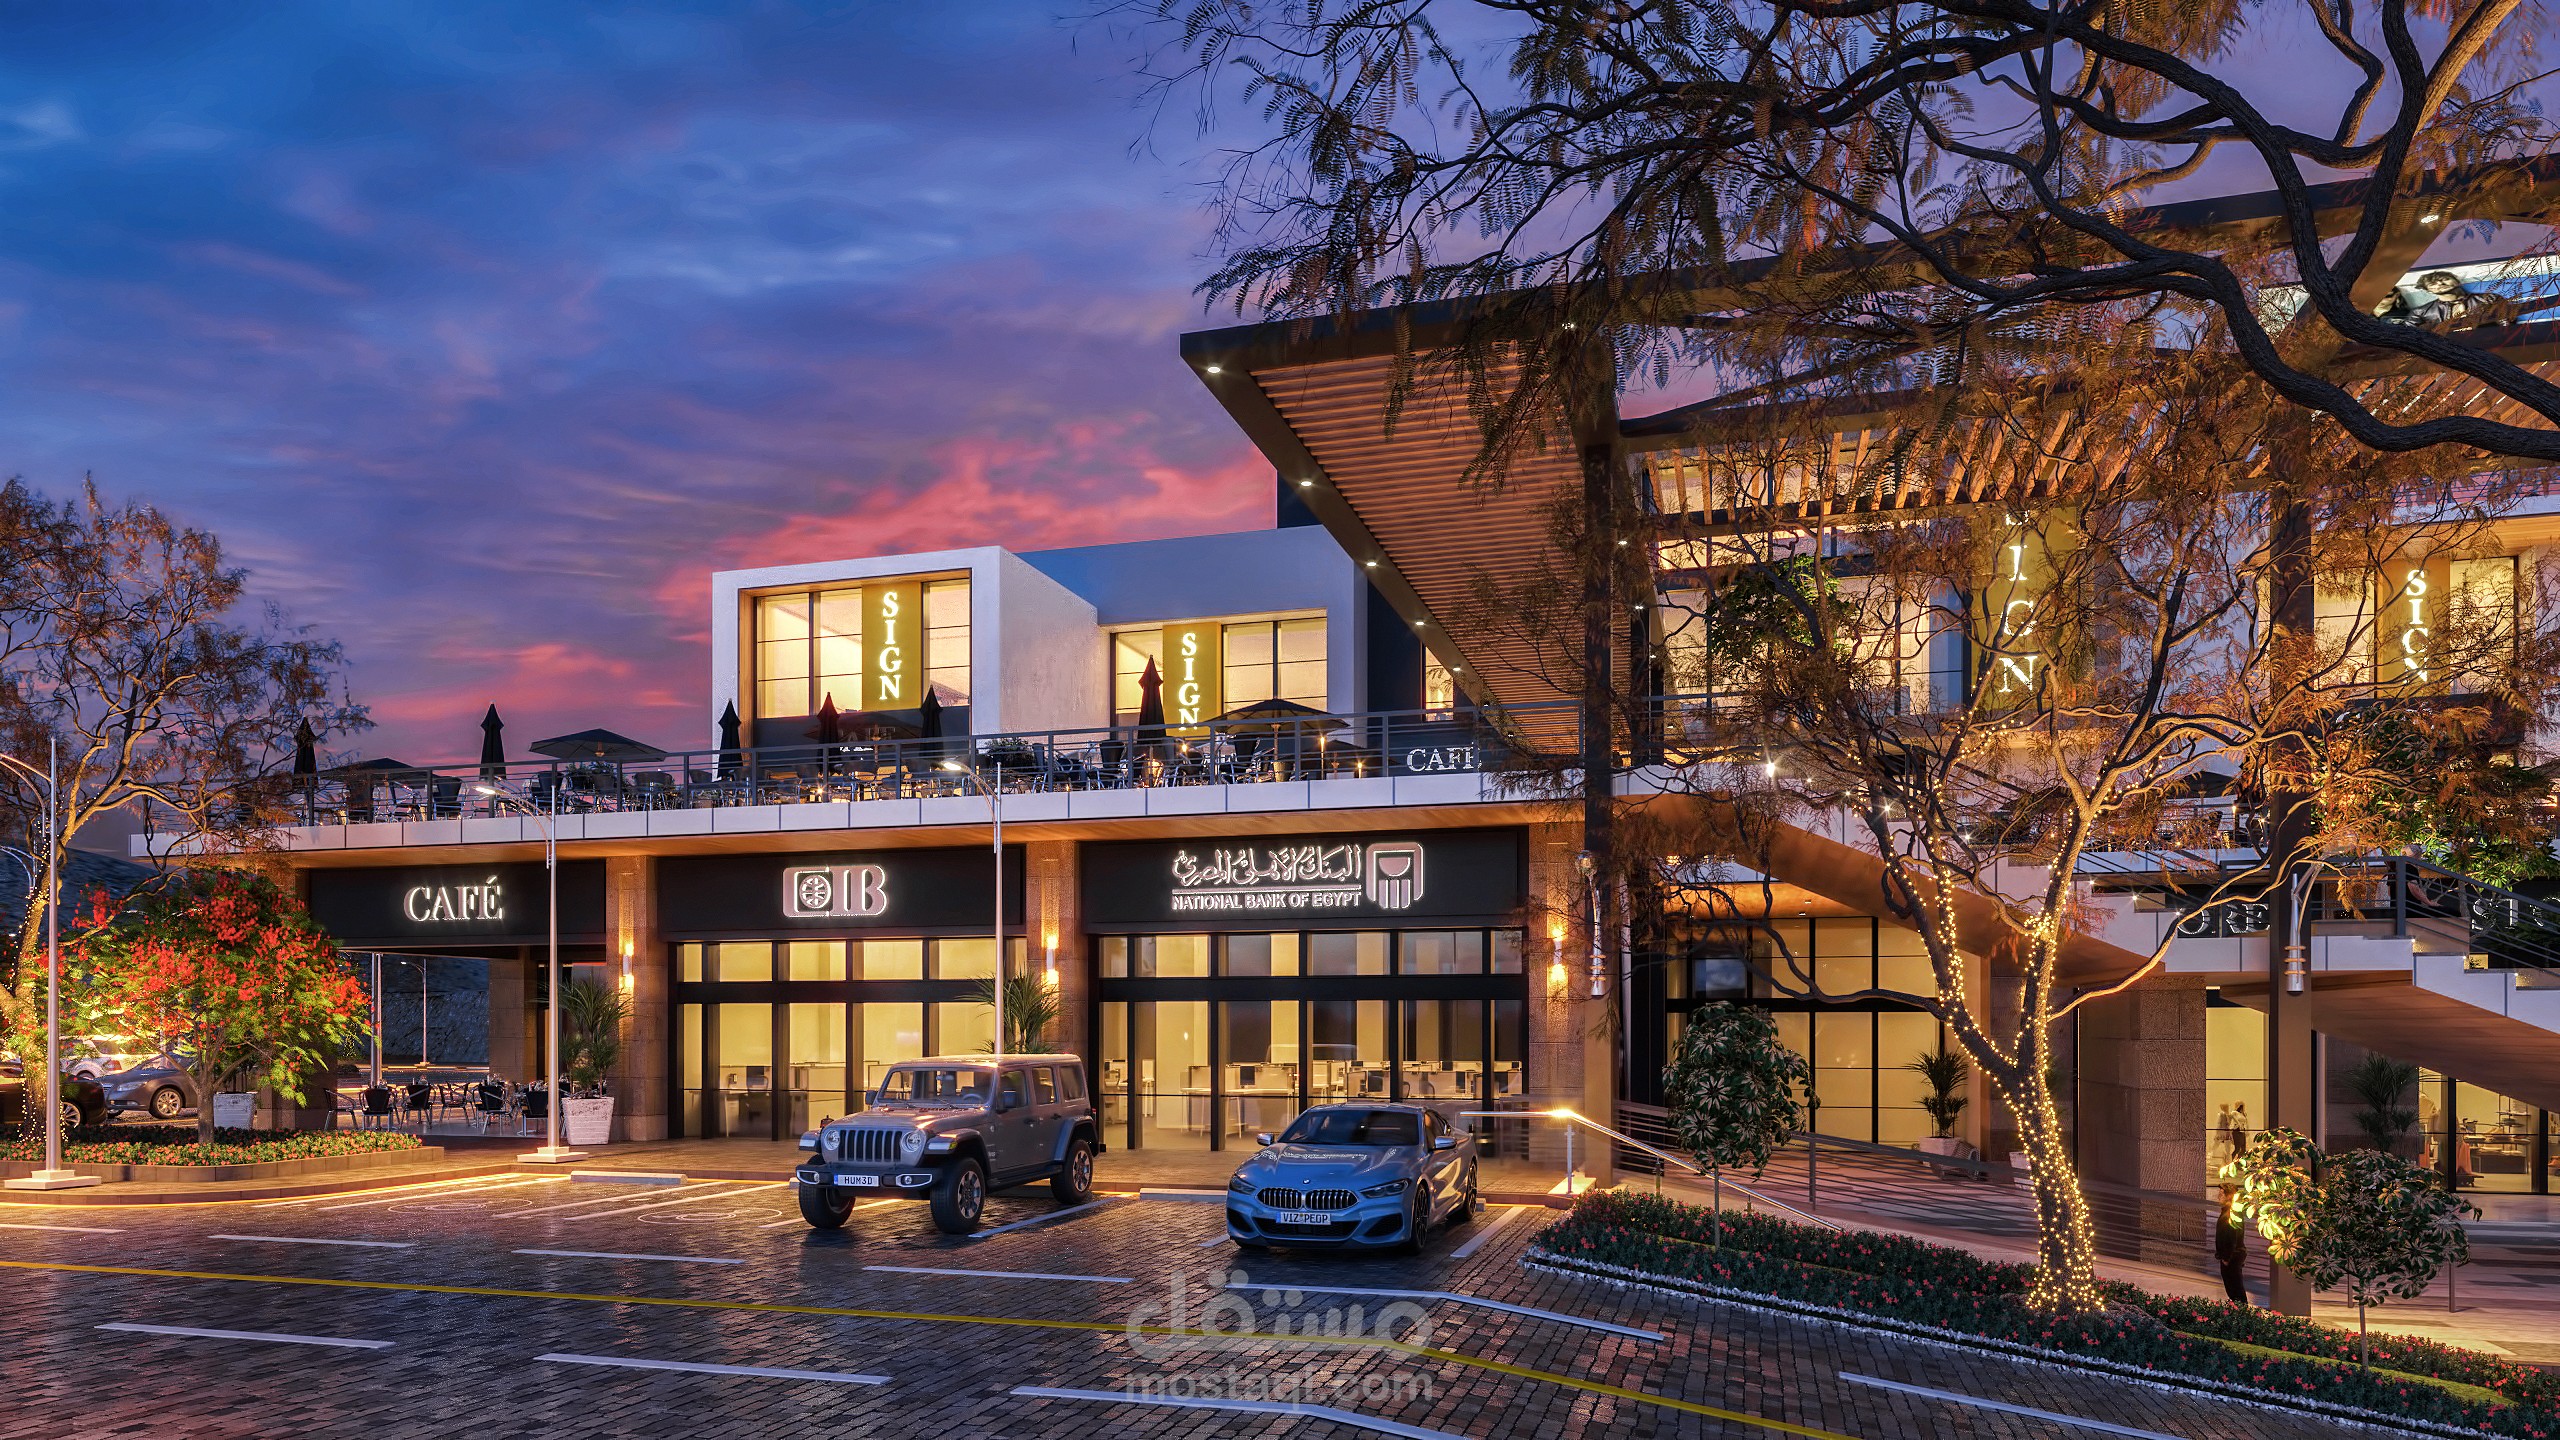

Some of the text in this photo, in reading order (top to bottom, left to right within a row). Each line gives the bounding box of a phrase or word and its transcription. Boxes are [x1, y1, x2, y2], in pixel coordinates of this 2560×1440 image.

[879, 591, 902, 700] SIGN
[1178, 632, 1200, 730] SIGN
[403, 875, 504, 922] CAFÉ
[1172, 891, 1361, 910] NATIONAL BANK OF EGYPT
[844, 1176, 873, 1185] HUM3D
